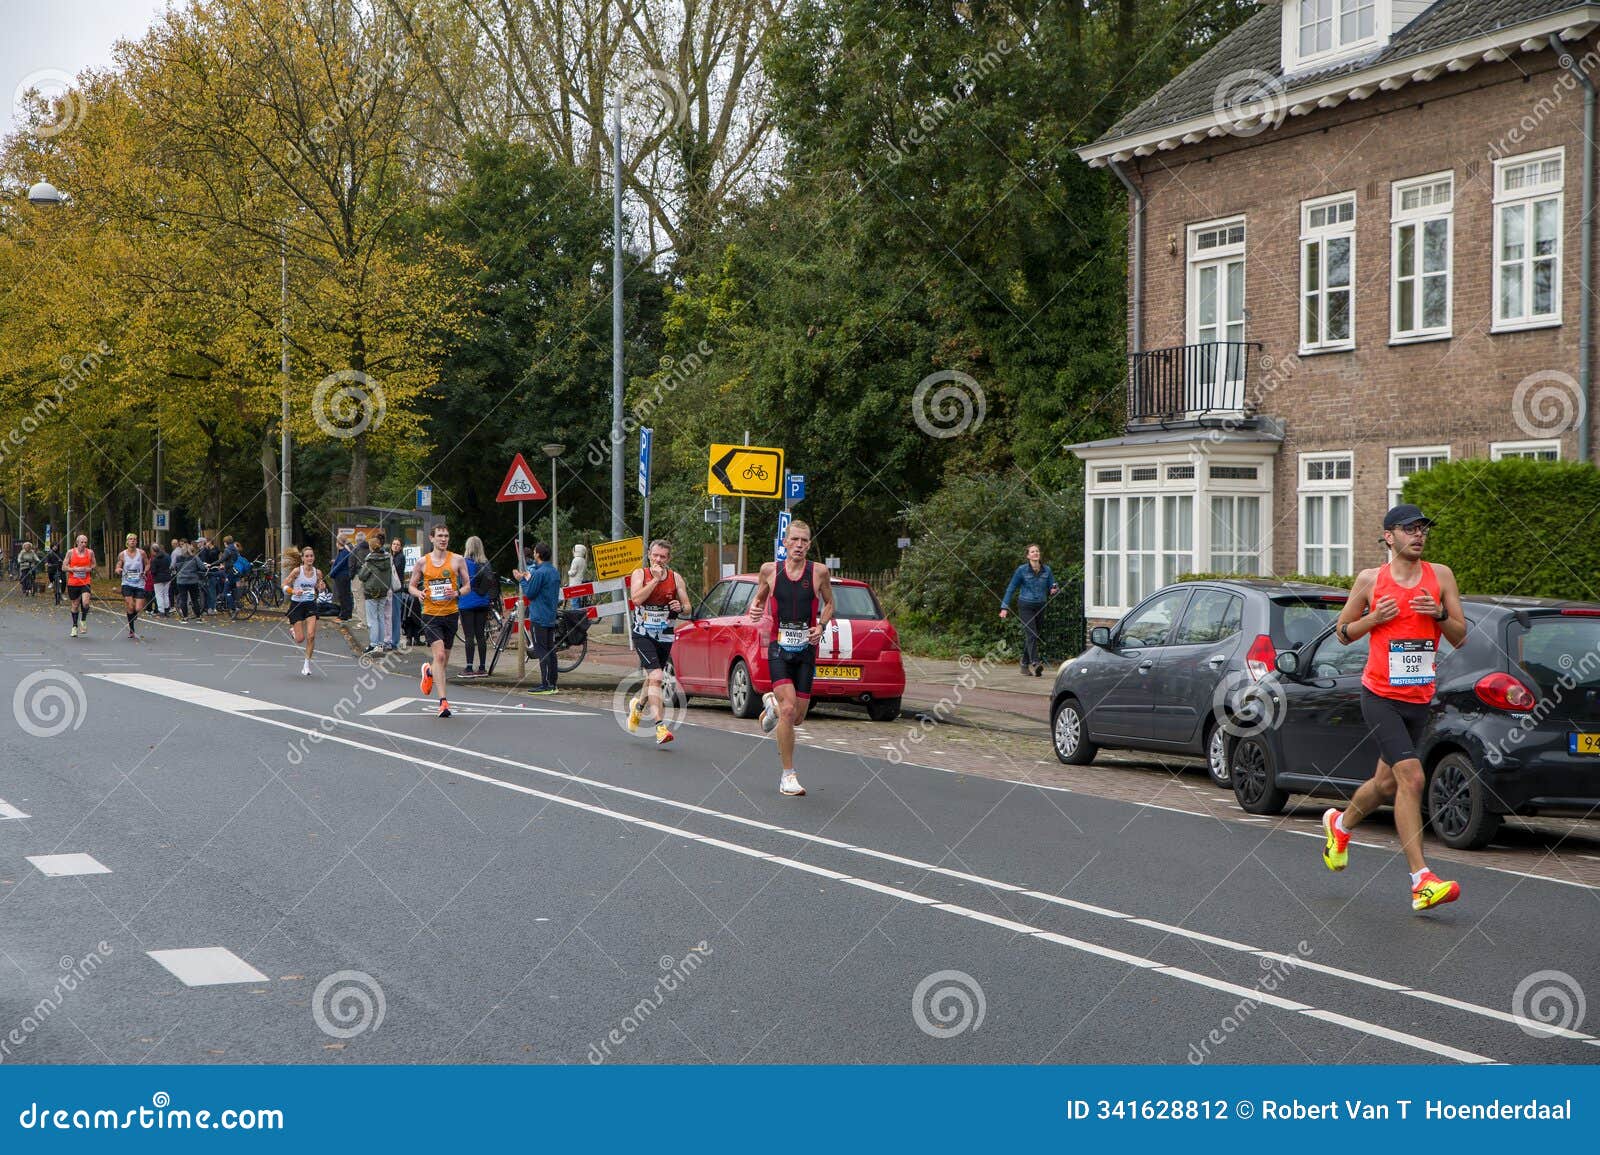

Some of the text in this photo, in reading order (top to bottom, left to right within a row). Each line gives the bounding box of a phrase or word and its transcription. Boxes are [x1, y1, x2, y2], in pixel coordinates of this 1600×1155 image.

[791, 483, 799, 496] P
[1402, 655, 1422, 664] IGOR
[1406, 665, 1419, 673] 235
